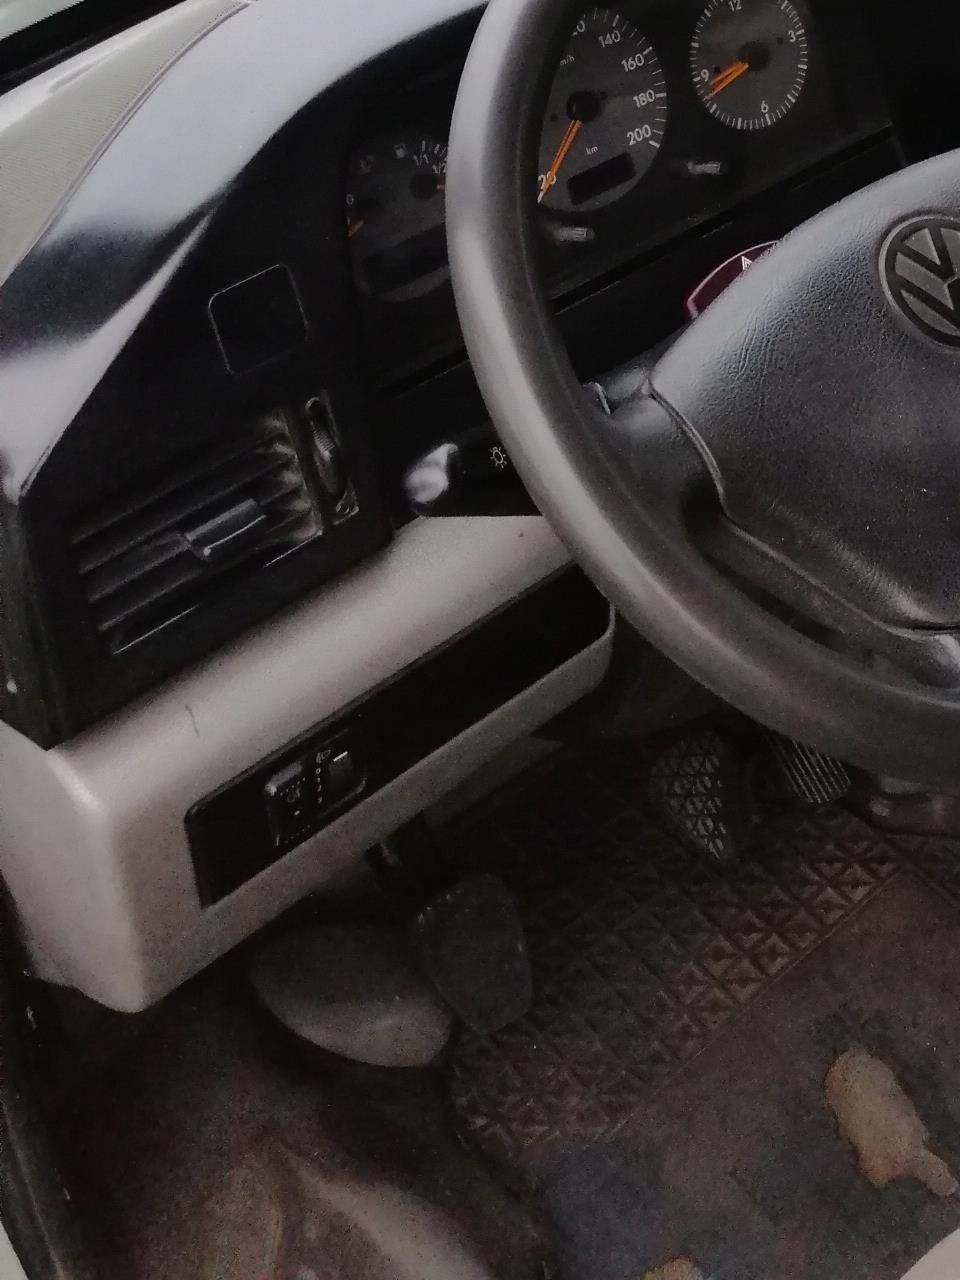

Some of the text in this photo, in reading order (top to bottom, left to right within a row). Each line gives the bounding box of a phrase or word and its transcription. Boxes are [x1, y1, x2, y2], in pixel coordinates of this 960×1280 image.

[598, 30, 621, 48] 140
[787, 30, 796, 42] 3
[621, 53, 645, 73] 160
[700, 70, 711, 82] 9
[633, 89, 656, 109] 180
[760, 100, 770, 113] 6
[626, 123, 652, 145] 200
[585, 145, 599, 156] km
